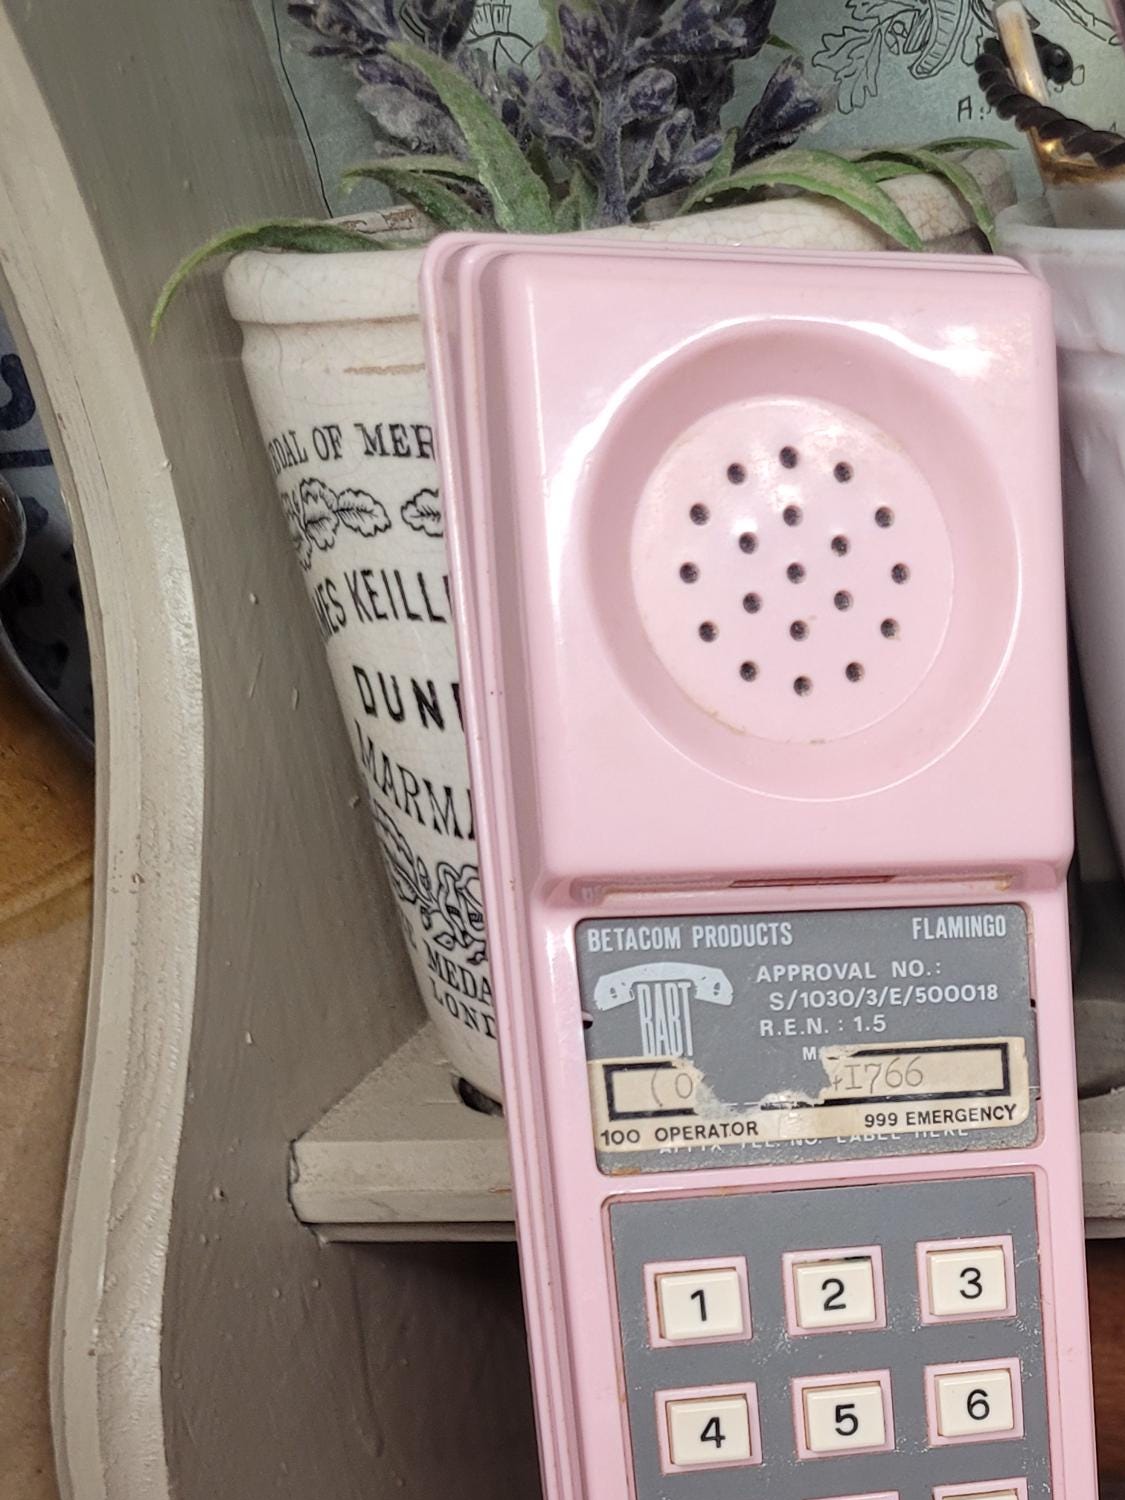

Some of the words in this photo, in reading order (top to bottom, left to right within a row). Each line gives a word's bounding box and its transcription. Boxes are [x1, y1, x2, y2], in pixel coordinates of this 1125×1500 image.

[312, 424, 342, 461] OF
[354, 422, 436, 461] MER
[587, 925, 682, 952] BETACOM
[692, 922, 794, 949] PRODUCTS
[911, 914, 1007, 940] FLAMINGO
[756, 962, 877, 983] APPROVAL
[769, 984, 999, 1012] S/1030/3/E/500018
[854, 1014, 887, 1033] 1.5
[864, 1112, 898, 1129] 999
[906, 1104, 1017, 1127] EMERGENCY
[601, 1129, 641, 1146] 100
[655, 1120, 759, 1142] OPERATOR
[690, 1289, 709, 1322] 1
[822, 1277, 848, 1311] 2
[959, 1266, 984, 1300] 3
[700, 1416, 726, 1449] 4
[834, 1402, 860, 1437] 5
[966, 1388, 991, 1421] 6
